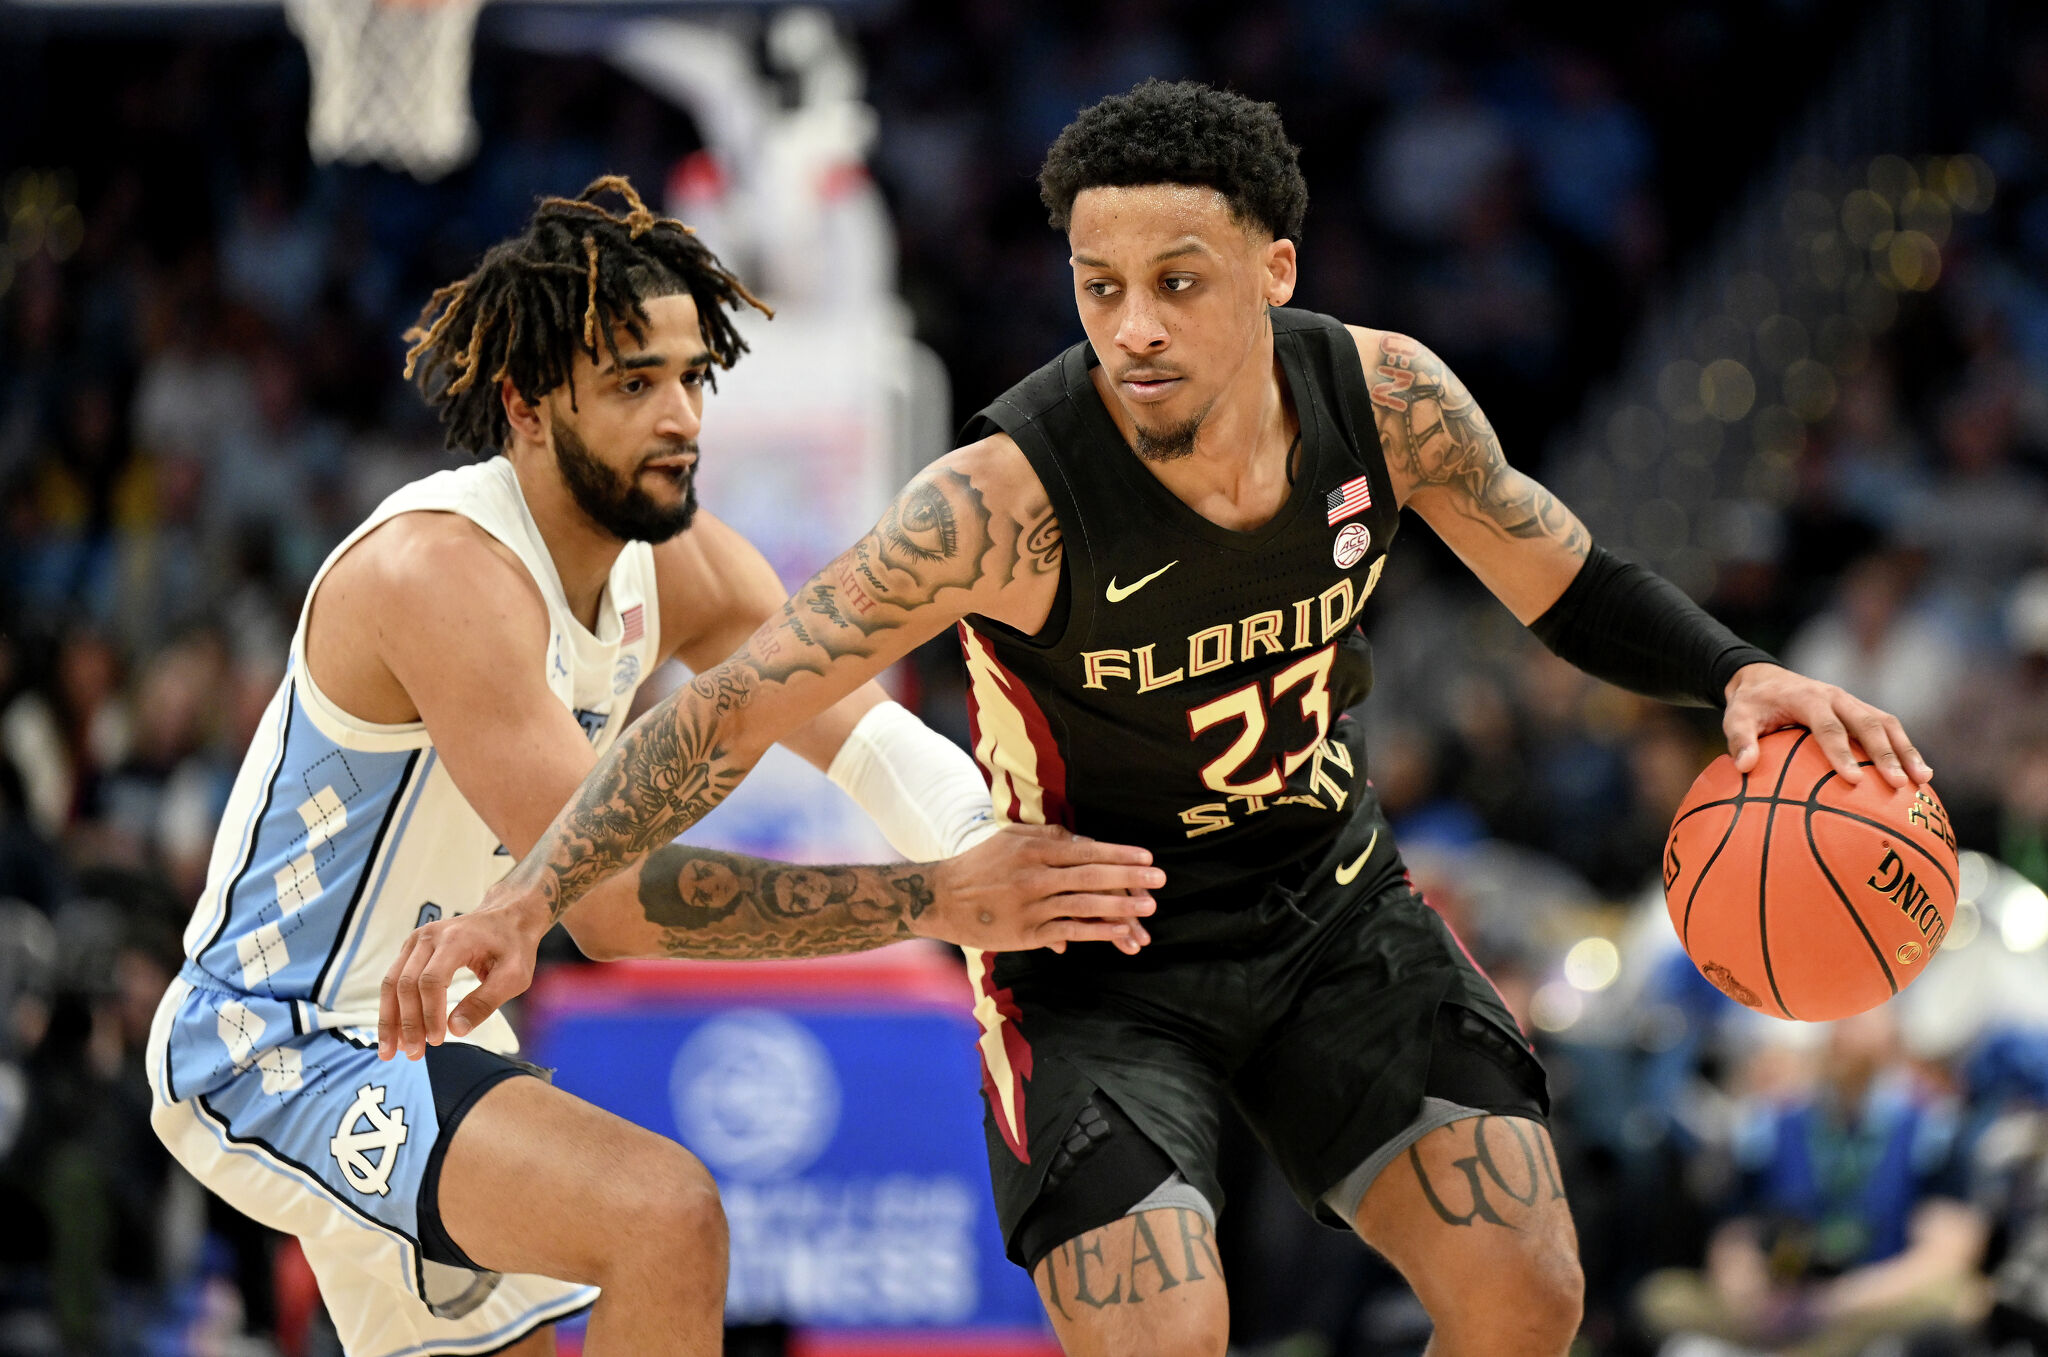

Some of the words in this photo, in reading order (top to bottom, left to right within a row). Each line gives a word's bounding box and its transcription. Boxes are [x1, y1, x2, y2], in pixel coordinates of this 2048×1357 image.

[1340, 532, 1365, 552] ACC
[836, 552, 877, 615] FAITH
[856, 562, 889, 592] your
[1080, 554, 1386, 694] FLORIDA
[1186, 642, 1337, 795] 23
